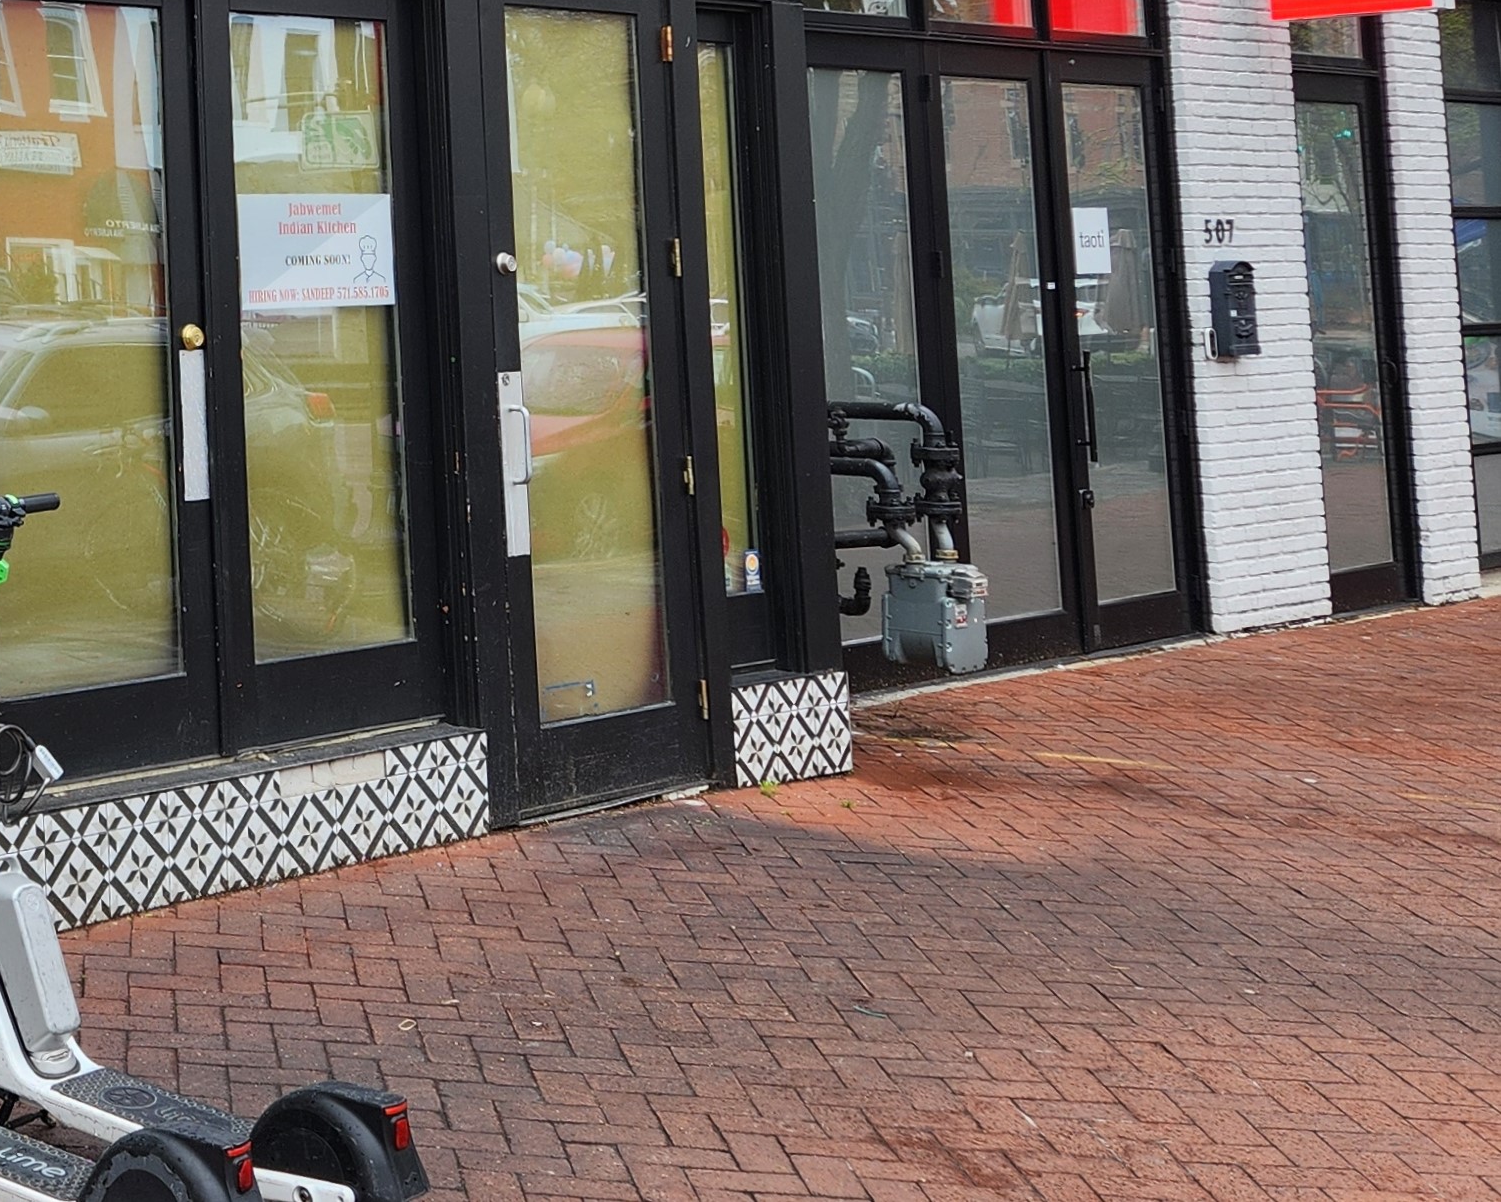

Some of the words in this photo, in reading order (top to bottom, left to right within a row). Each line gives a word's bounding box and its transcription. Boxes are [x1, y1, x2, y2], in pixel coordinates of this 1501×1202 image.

[287, 202, 342, 218] Jabwemet
[278, 221, 314, 235] Indian
[316, 220, 357, 235] Kitchen
[1203, 218, 1235, 244] 507
[1078, 228, 1106, 249] taoti
[284, 254, 322, 267] COMING
[323, 253, 351, 266] SOON!
[248, 288, 277, 304] HIRING
[278, 288, 300, 303] NOW:
[301, 286, 336, 301] SANDEEP
[337, 284, 390, 300] 571.585.1705
